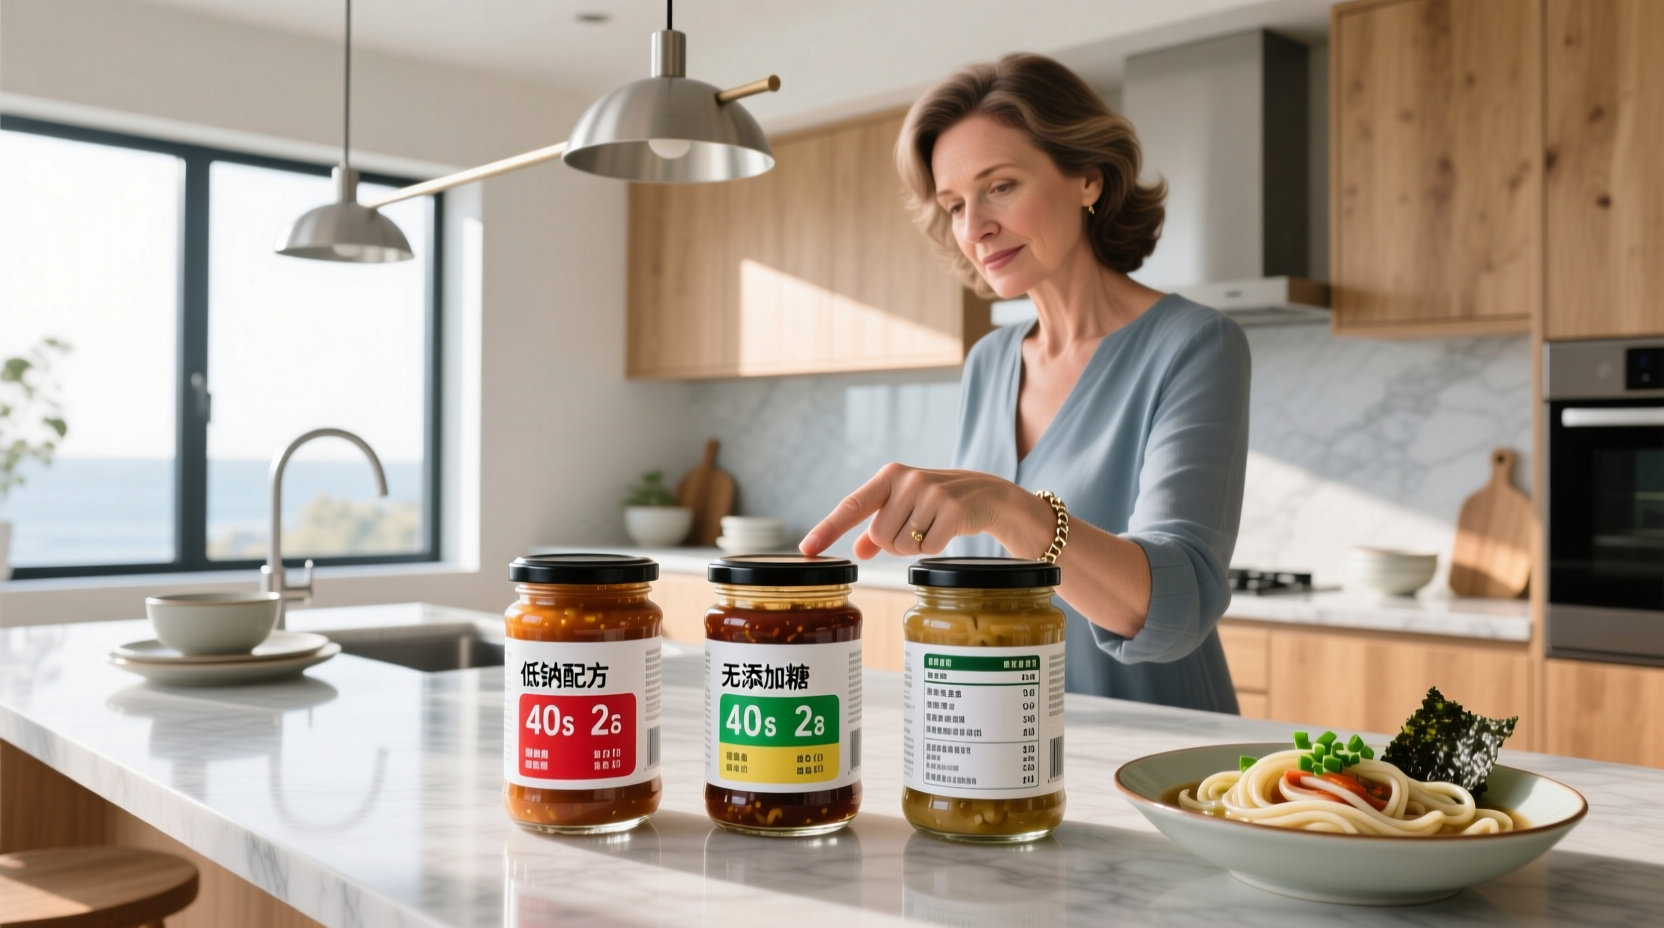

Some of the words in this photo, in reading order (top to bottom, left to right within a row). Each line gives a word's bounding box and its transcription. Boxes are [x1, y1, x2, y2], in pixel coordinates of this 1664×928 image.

[521, 661, 609, 688] 低钠配方
[722, 663, 810, 690] 无添加糖
[525, 703, 575, 736] 40s
[726, 704, 777, 737] 40s
